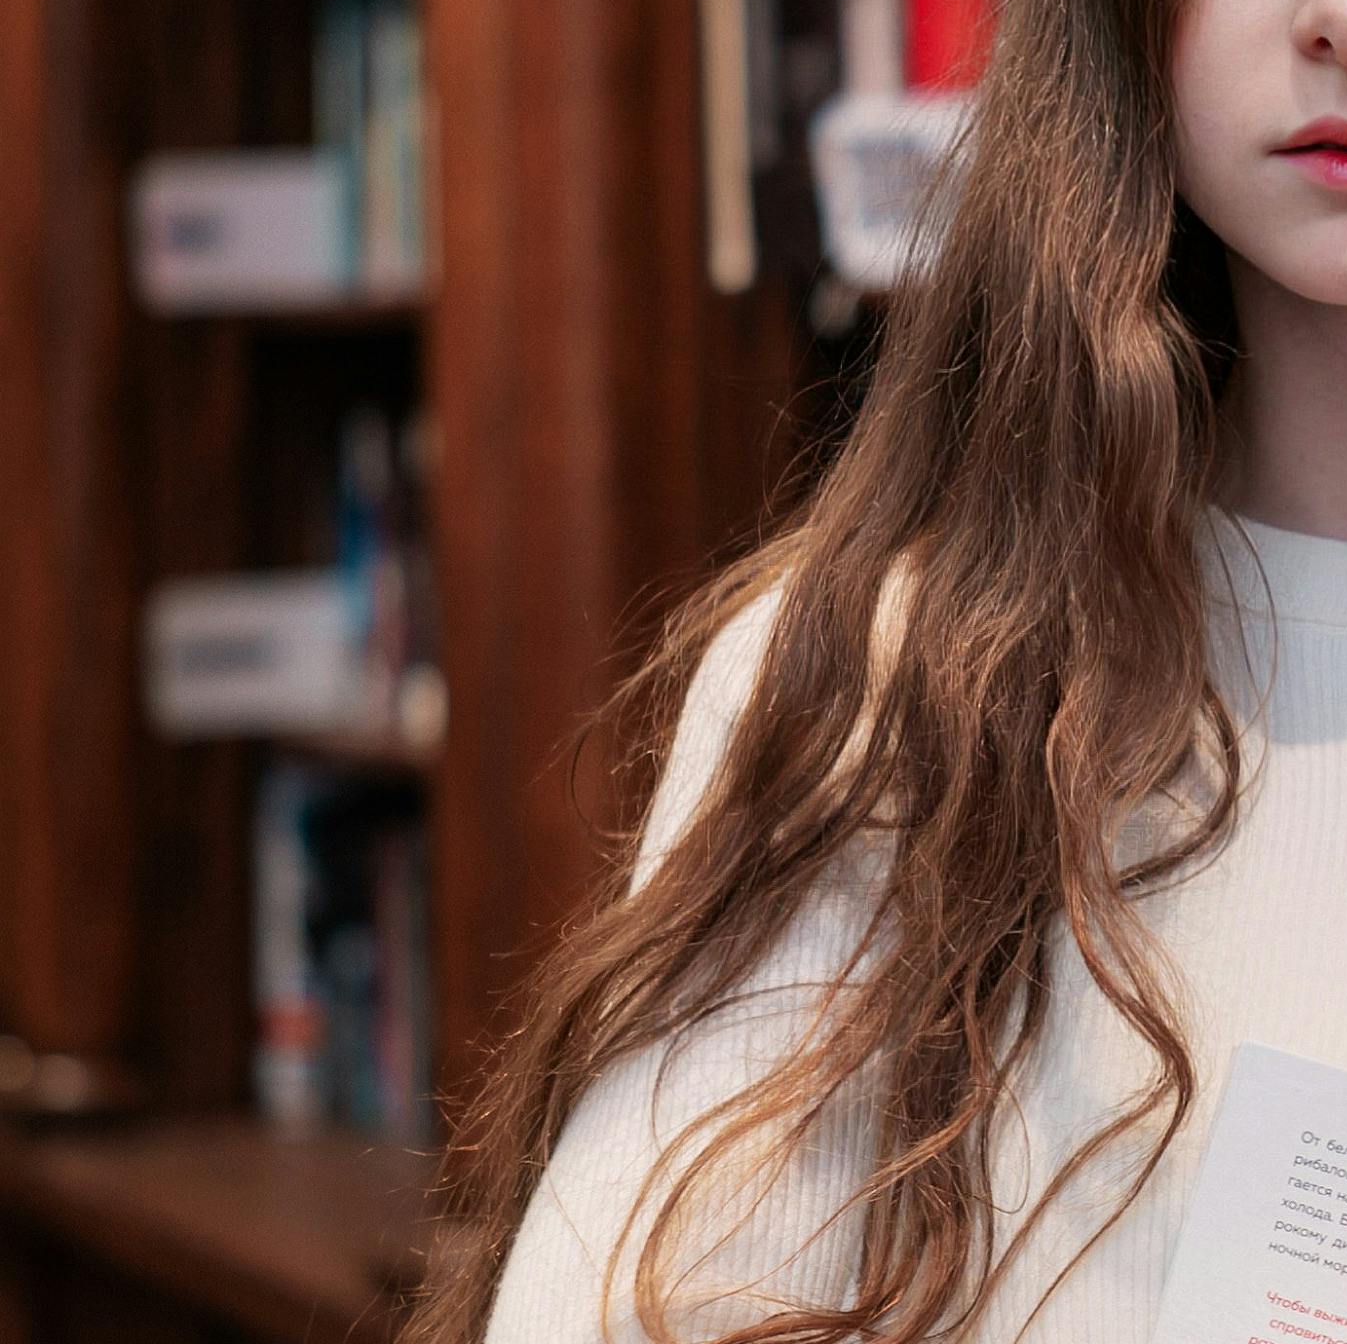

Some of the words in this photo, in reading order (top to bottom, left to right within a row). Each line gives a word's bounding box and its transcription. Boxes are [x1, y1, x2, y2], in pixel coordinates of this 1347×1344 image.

[1301, 1131, 1321, 1146] От
[1288, 1176, 1332, 1197] гается
[1281, 1198, 1333, 1221] холода.
[1274, 1220, 1328, 1244] рокому
[1269, 1242, 1319, 1264] ночной
[1267, 1288, 1312, 1314] Чтобы
